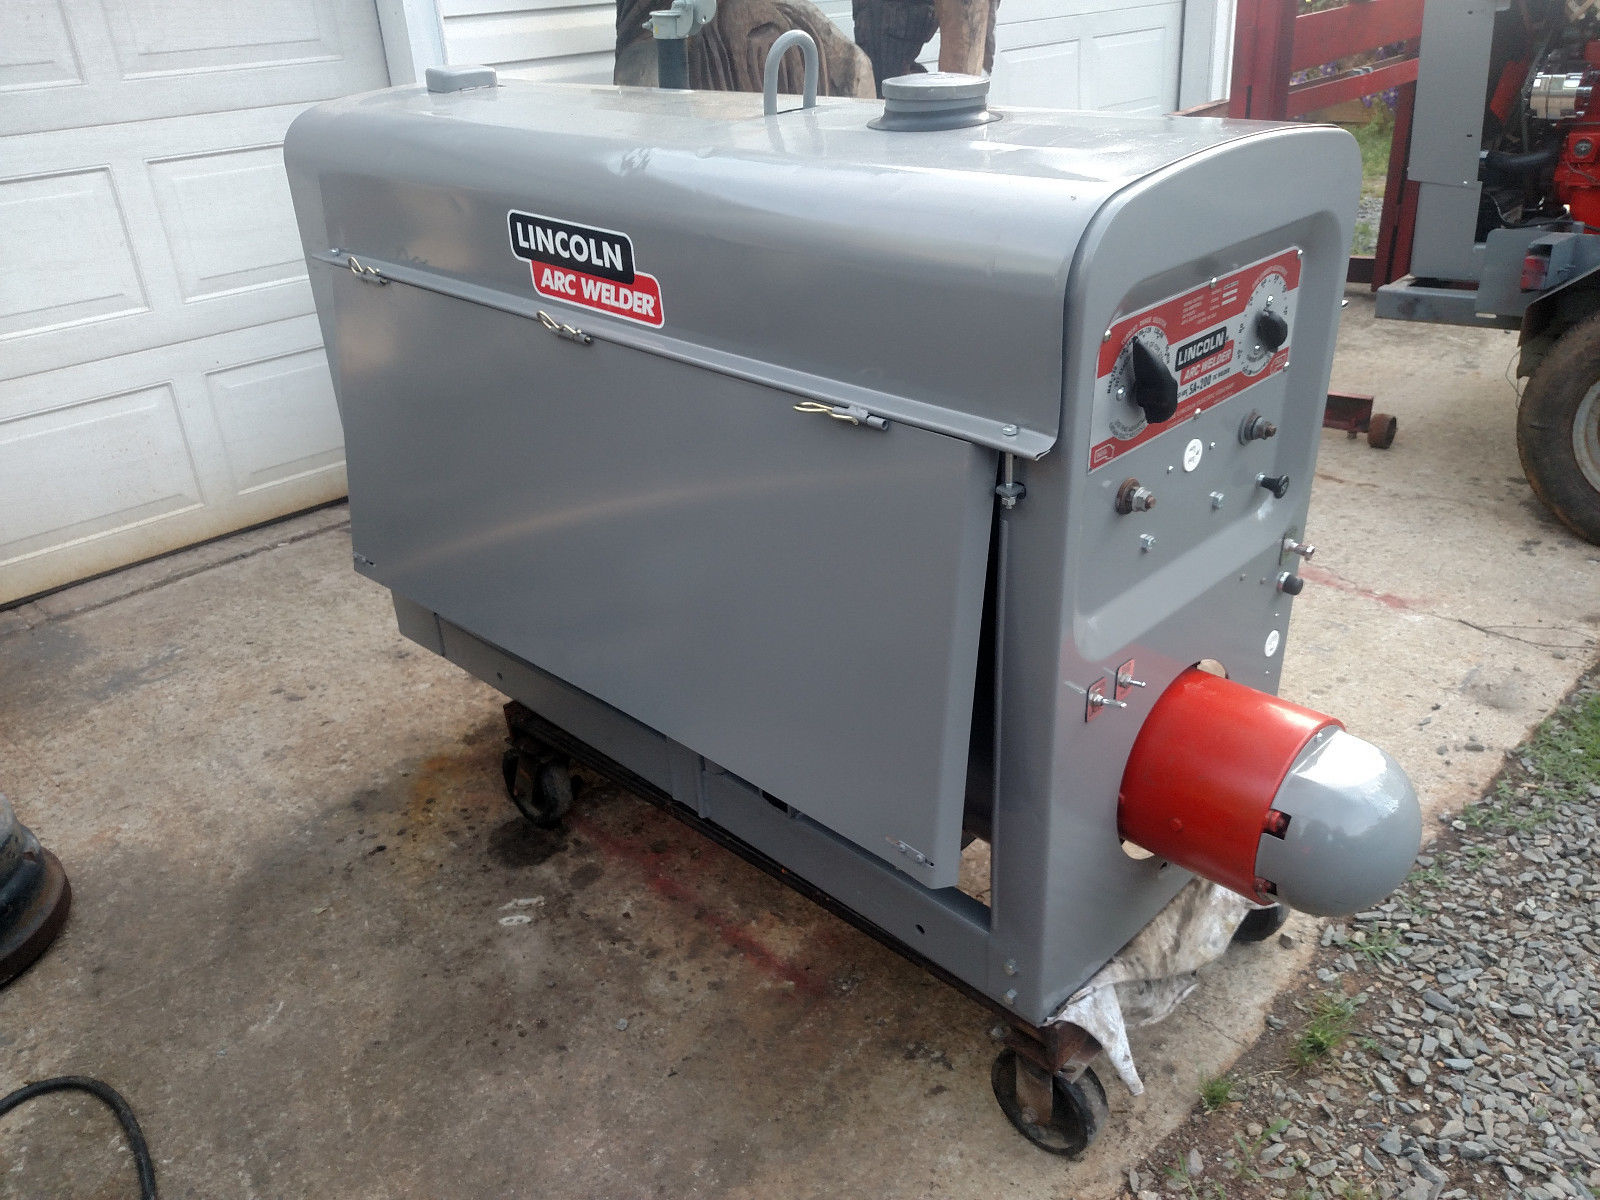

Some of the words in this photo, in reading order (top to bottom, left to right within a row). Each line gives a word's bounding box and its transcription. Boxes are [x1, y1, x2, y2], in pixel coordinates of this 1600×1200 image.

[516, 222, 624, 272] LINCOLN
[541, 268, 576, 296] ARC
[580, 277, 655, 317] WELDER
[1178, 331, 1225, 366] LINCOLN
[1183, 364, 1201, 382] ARC
[1201, 348, 1232, 372] WELDER
[1189, 374, 1212, 395] SA-200
